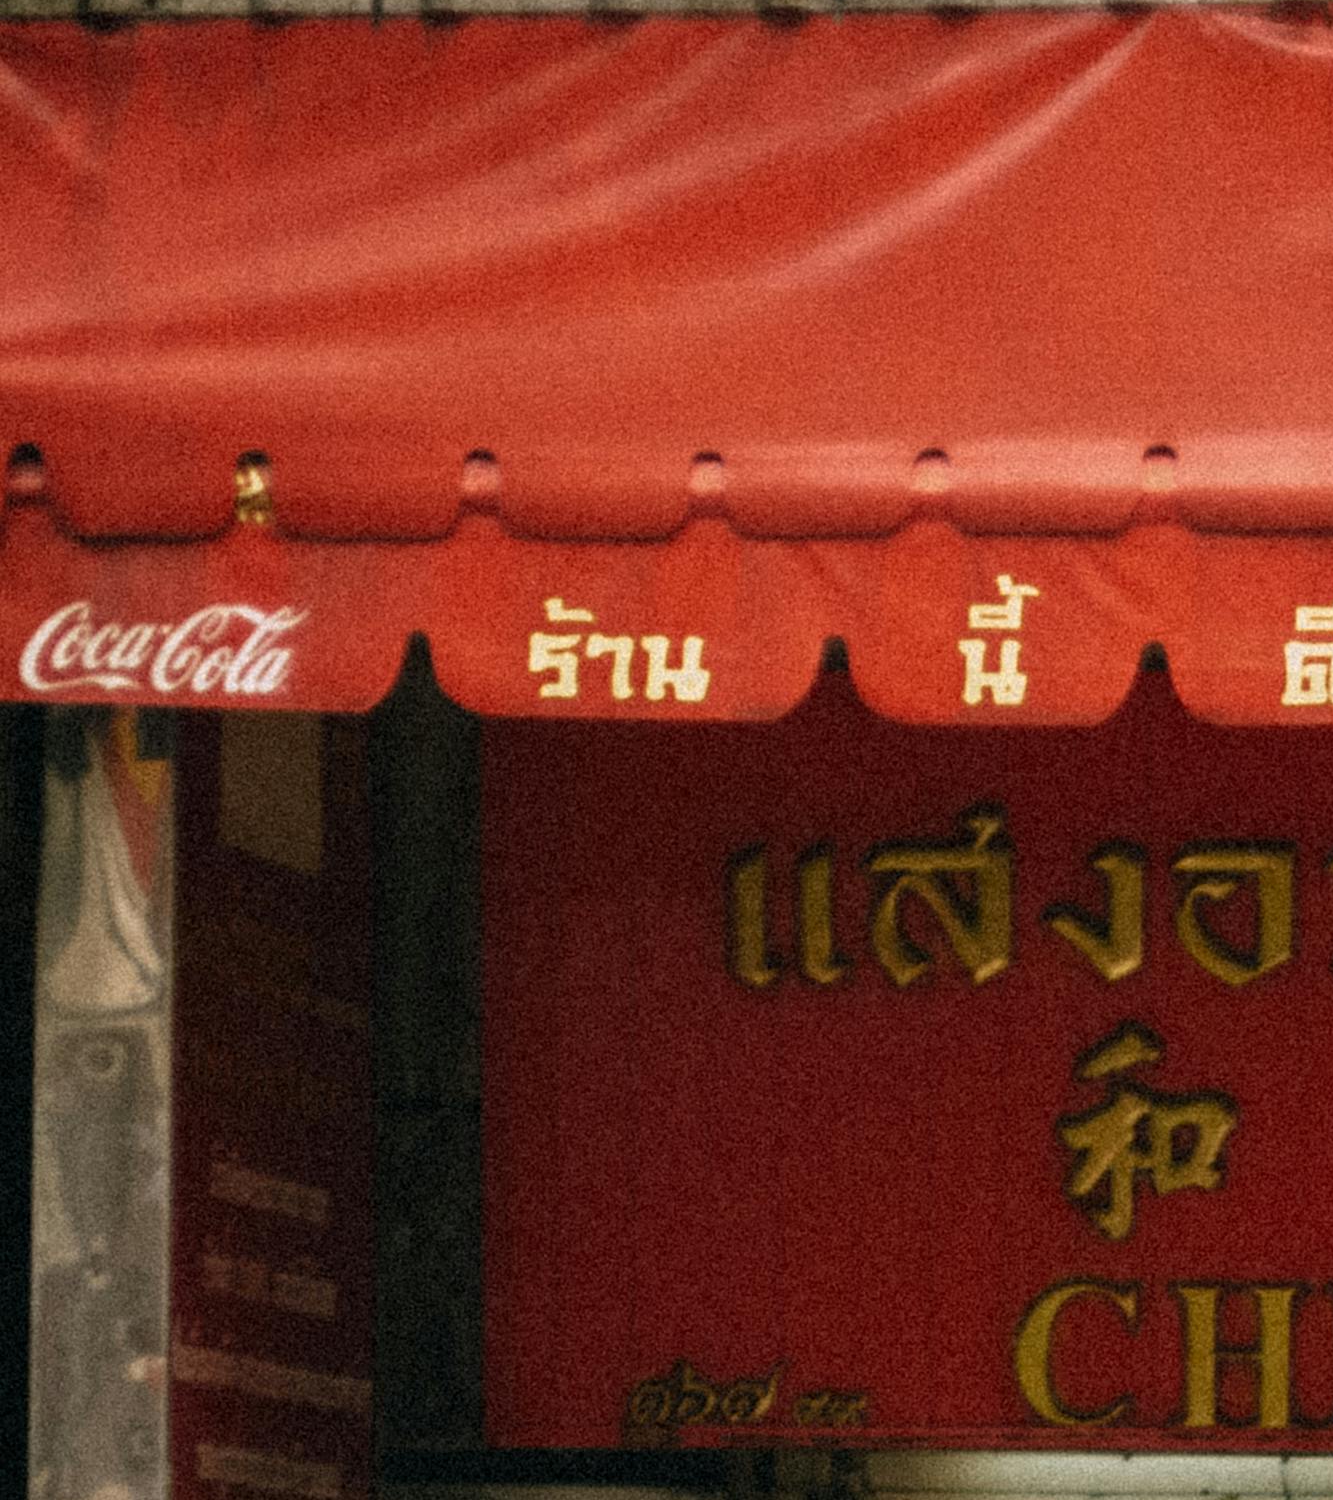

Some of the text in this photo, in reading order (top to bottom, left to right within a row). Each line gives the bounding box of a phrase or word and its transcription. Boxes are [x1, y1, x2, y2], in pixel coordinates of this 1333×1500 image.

[20, 600, 308, 696] Coca-Cola
[529, 598, 710, 702] ร้าน
[960, 575, 1039, 705] นี้
